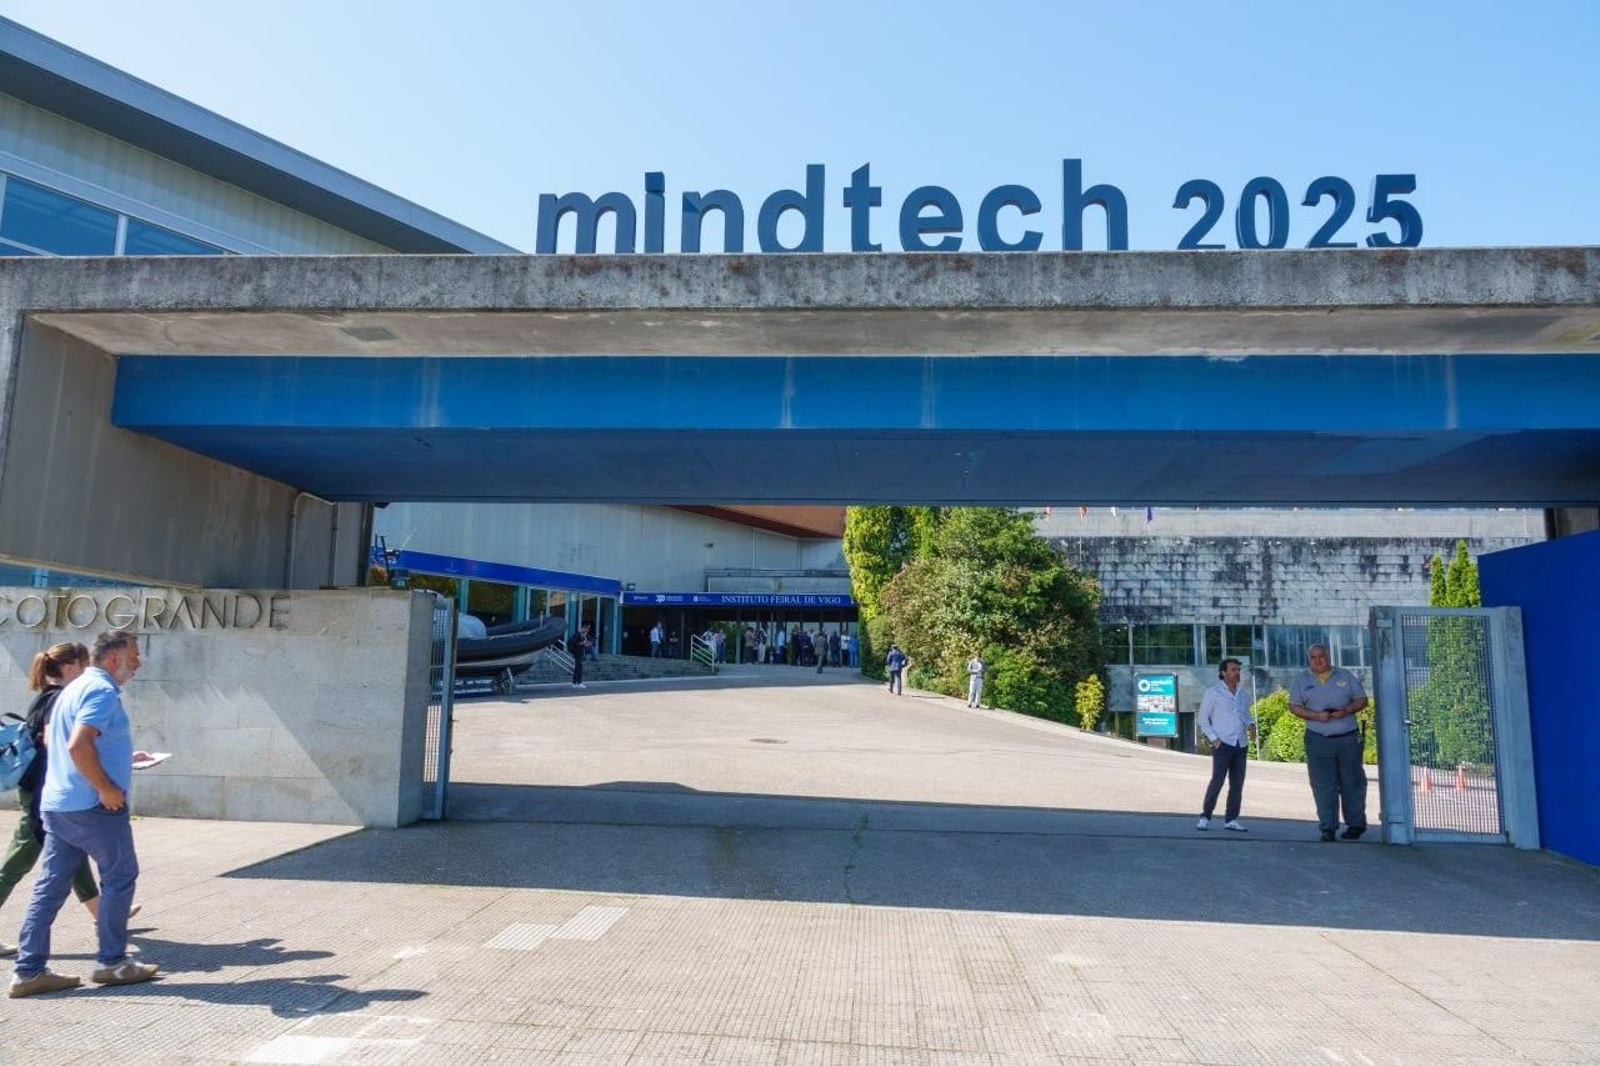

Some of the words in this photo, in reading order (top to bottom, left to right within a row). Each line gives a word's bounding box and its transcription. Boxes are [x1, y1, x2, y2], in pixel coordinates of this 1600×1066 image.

[535, 158, 1129, 254] mindtech
[1172, 173, 1424, 250] 2025
[721, 595, 768, 604] INSTITUTO
[770, 595, 801, 604] FEIRAL
[804, 595, 817, 604] DE
[819, 596, 841, 605] VIGO
